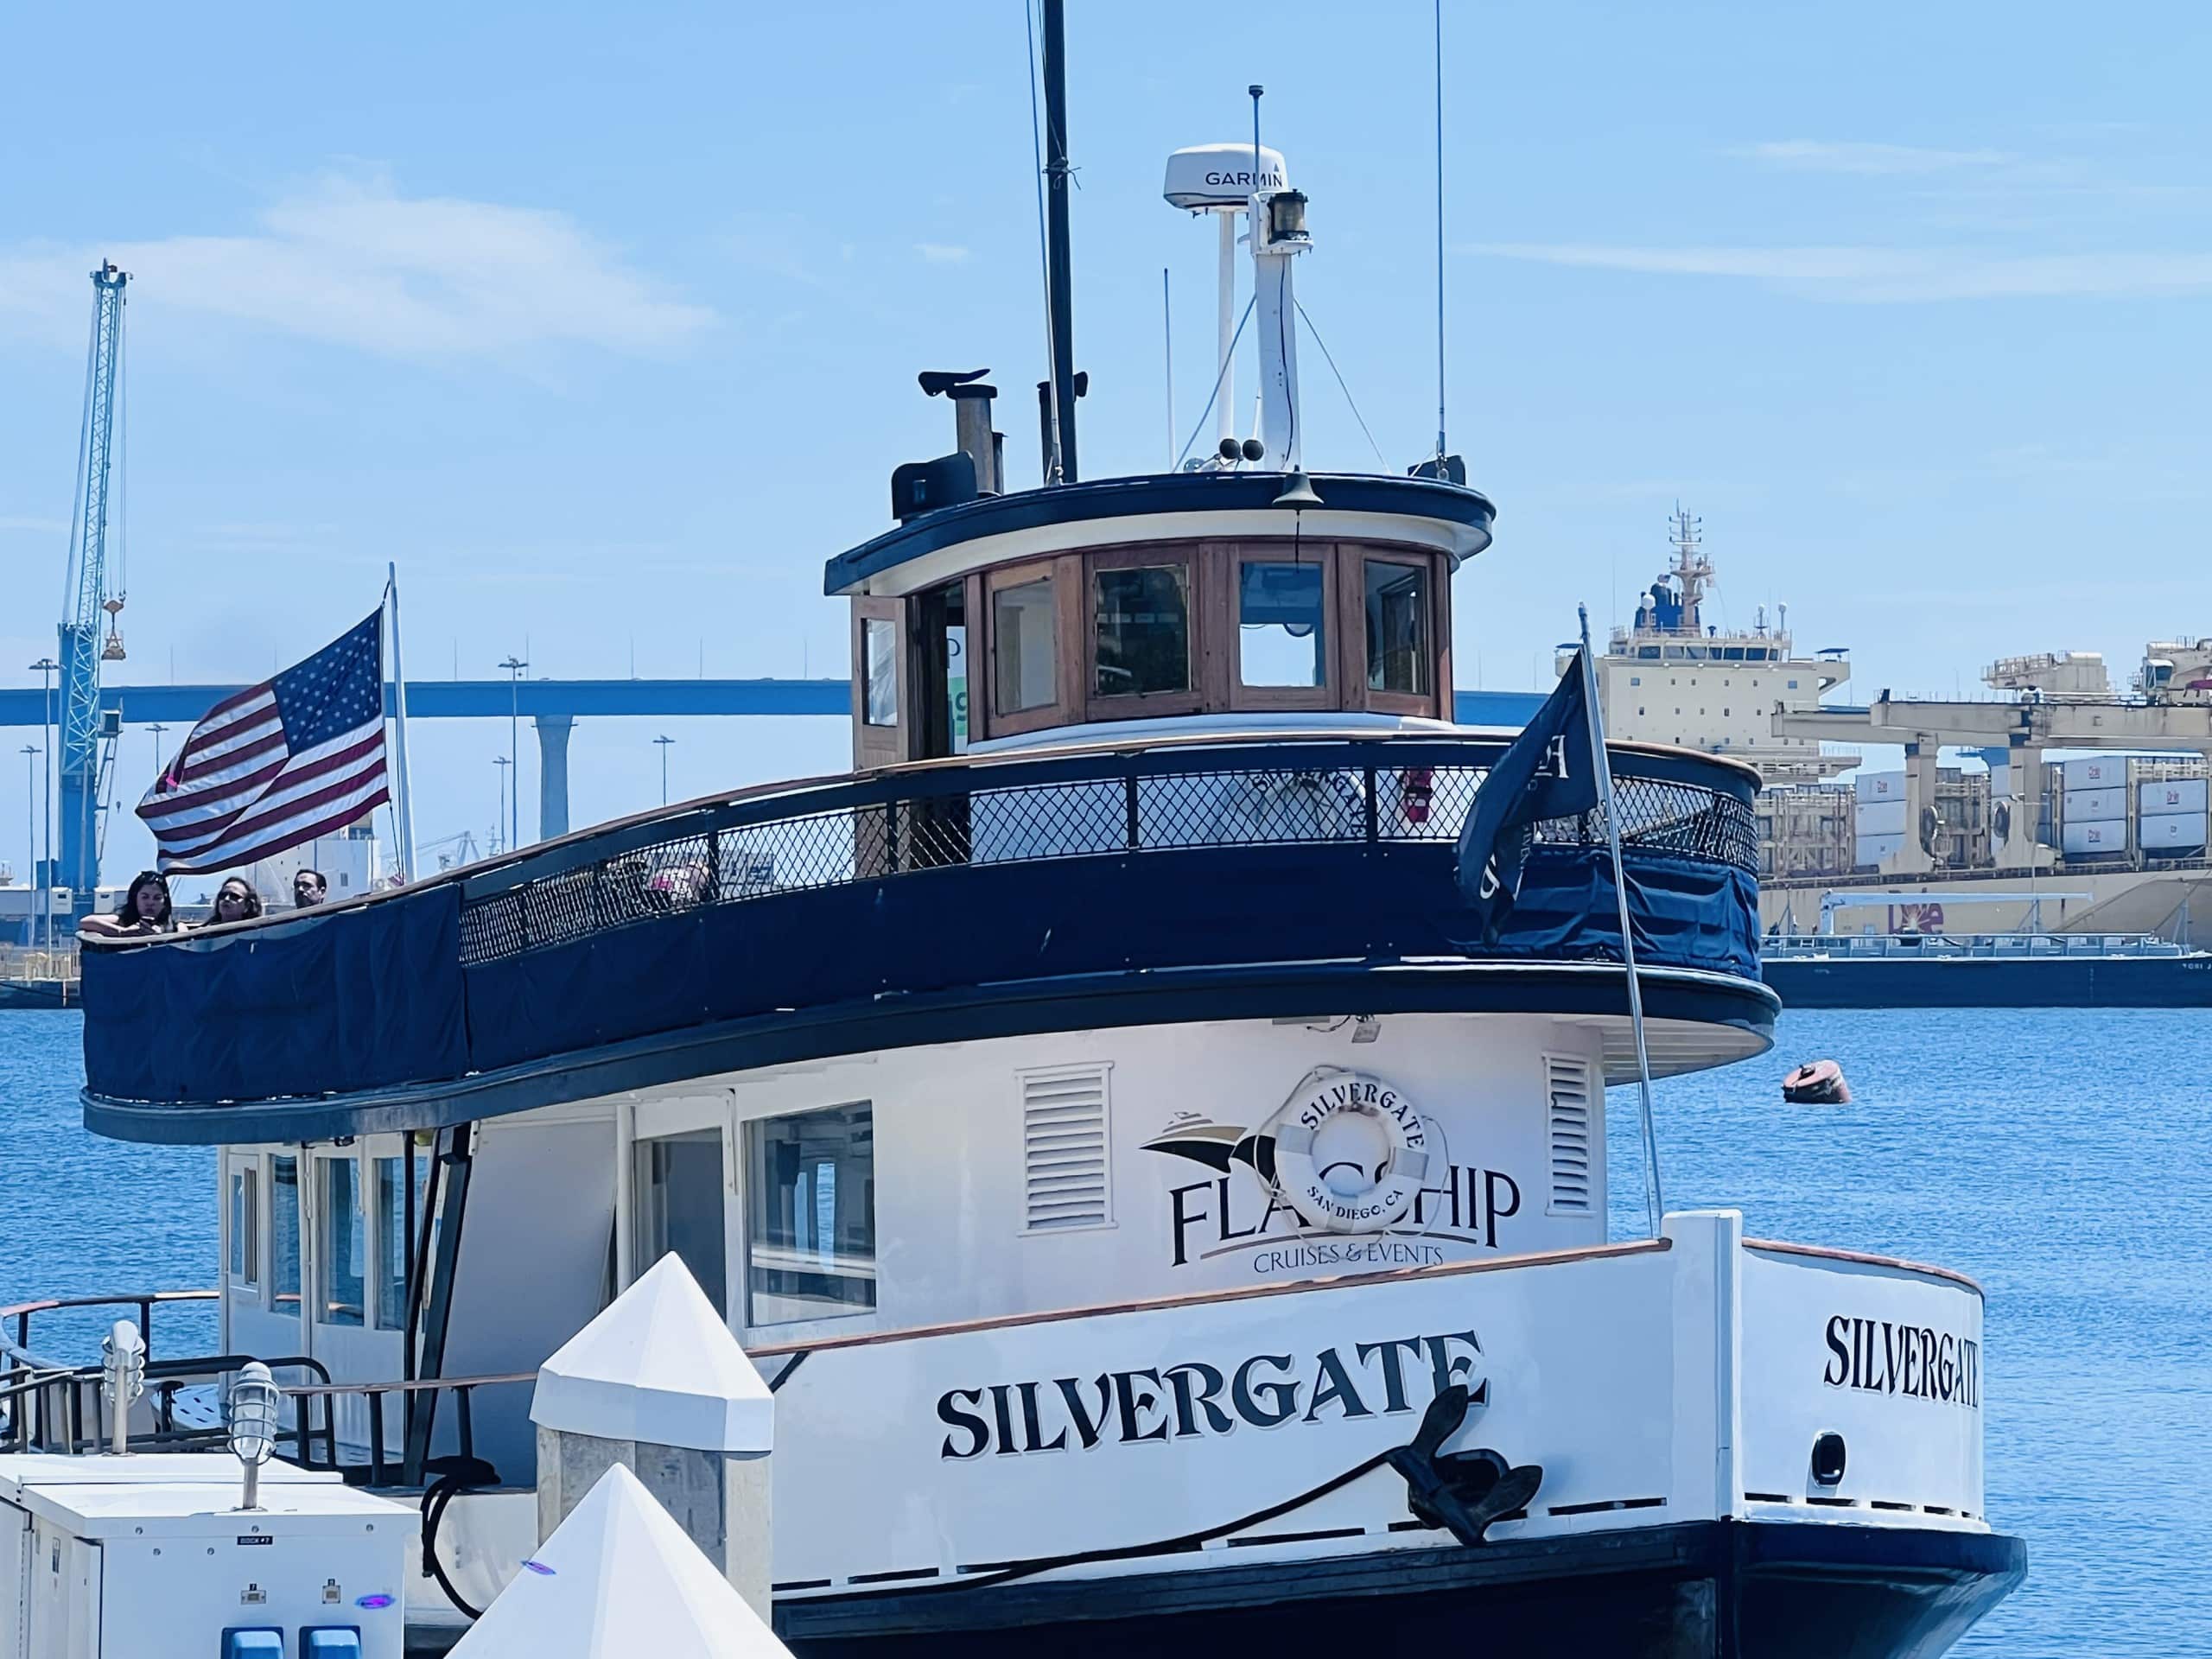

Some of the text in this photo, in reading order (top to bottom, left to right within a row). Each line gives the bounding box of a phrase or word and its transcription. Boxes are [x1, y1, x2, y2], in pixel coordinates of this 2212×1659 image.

[1205, 172, 1282, 187] GARMIN
[1300, 1083, 1424, 1148] SILVERGATE
[1169, 1162, 1521, 1268] FLAHIP
[1306, 1186, 1333, 1211] SAN
[1385, 1190, 1403, 1206] CA
[1254, 1243, 1444, 1273] CRUISES & EVENTS
[937, 1329, 1490, 1459] SILVERGATE
[1824, 1315, 1978, 1408] SILVERGATE
